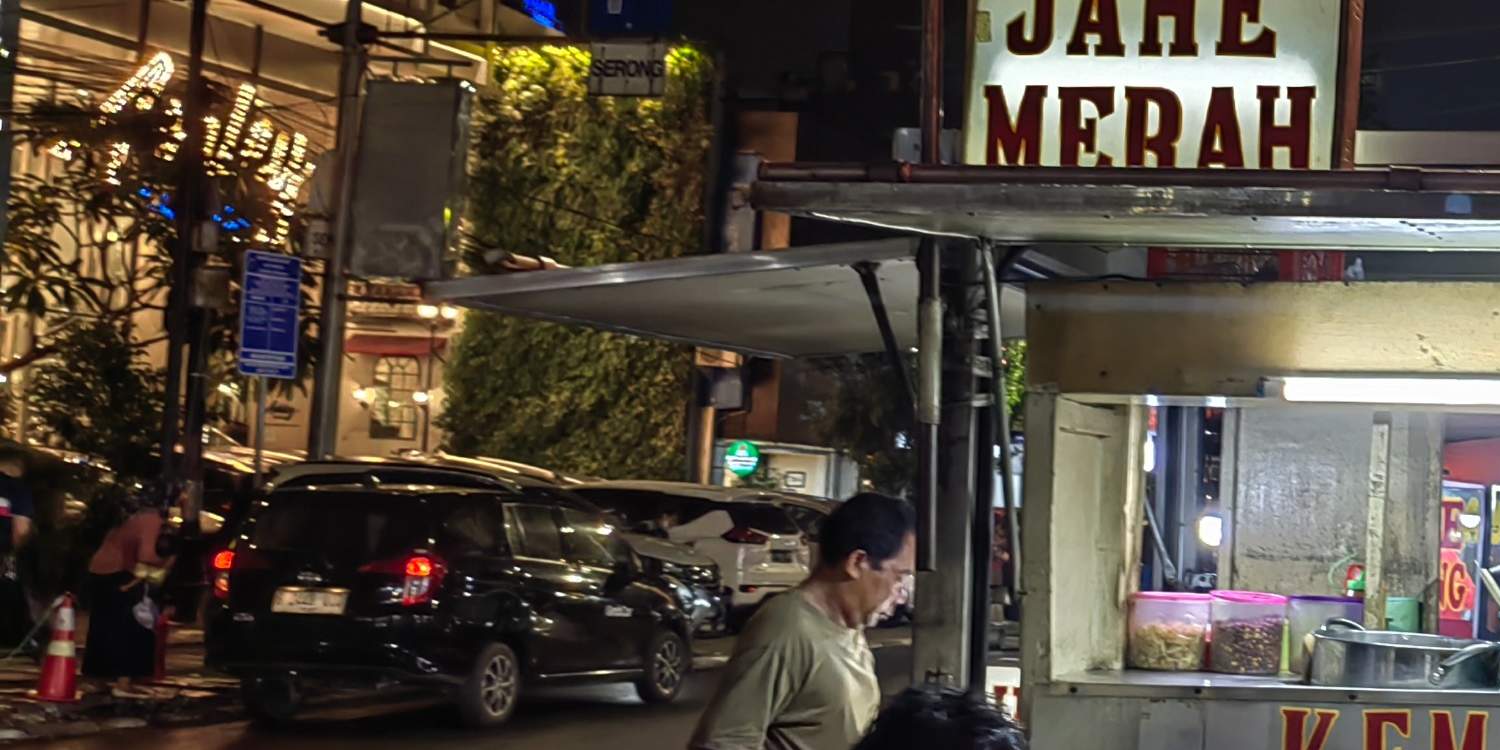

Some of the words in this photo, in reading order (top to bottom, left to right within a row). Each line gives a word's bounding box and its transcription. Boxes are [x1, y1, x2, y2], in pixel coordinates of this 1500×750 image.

[1006, 0, 1277, 57] JAHE
[591, 59, 664, 77] SERONG
[984, 85, 1317, 169] MERAH
